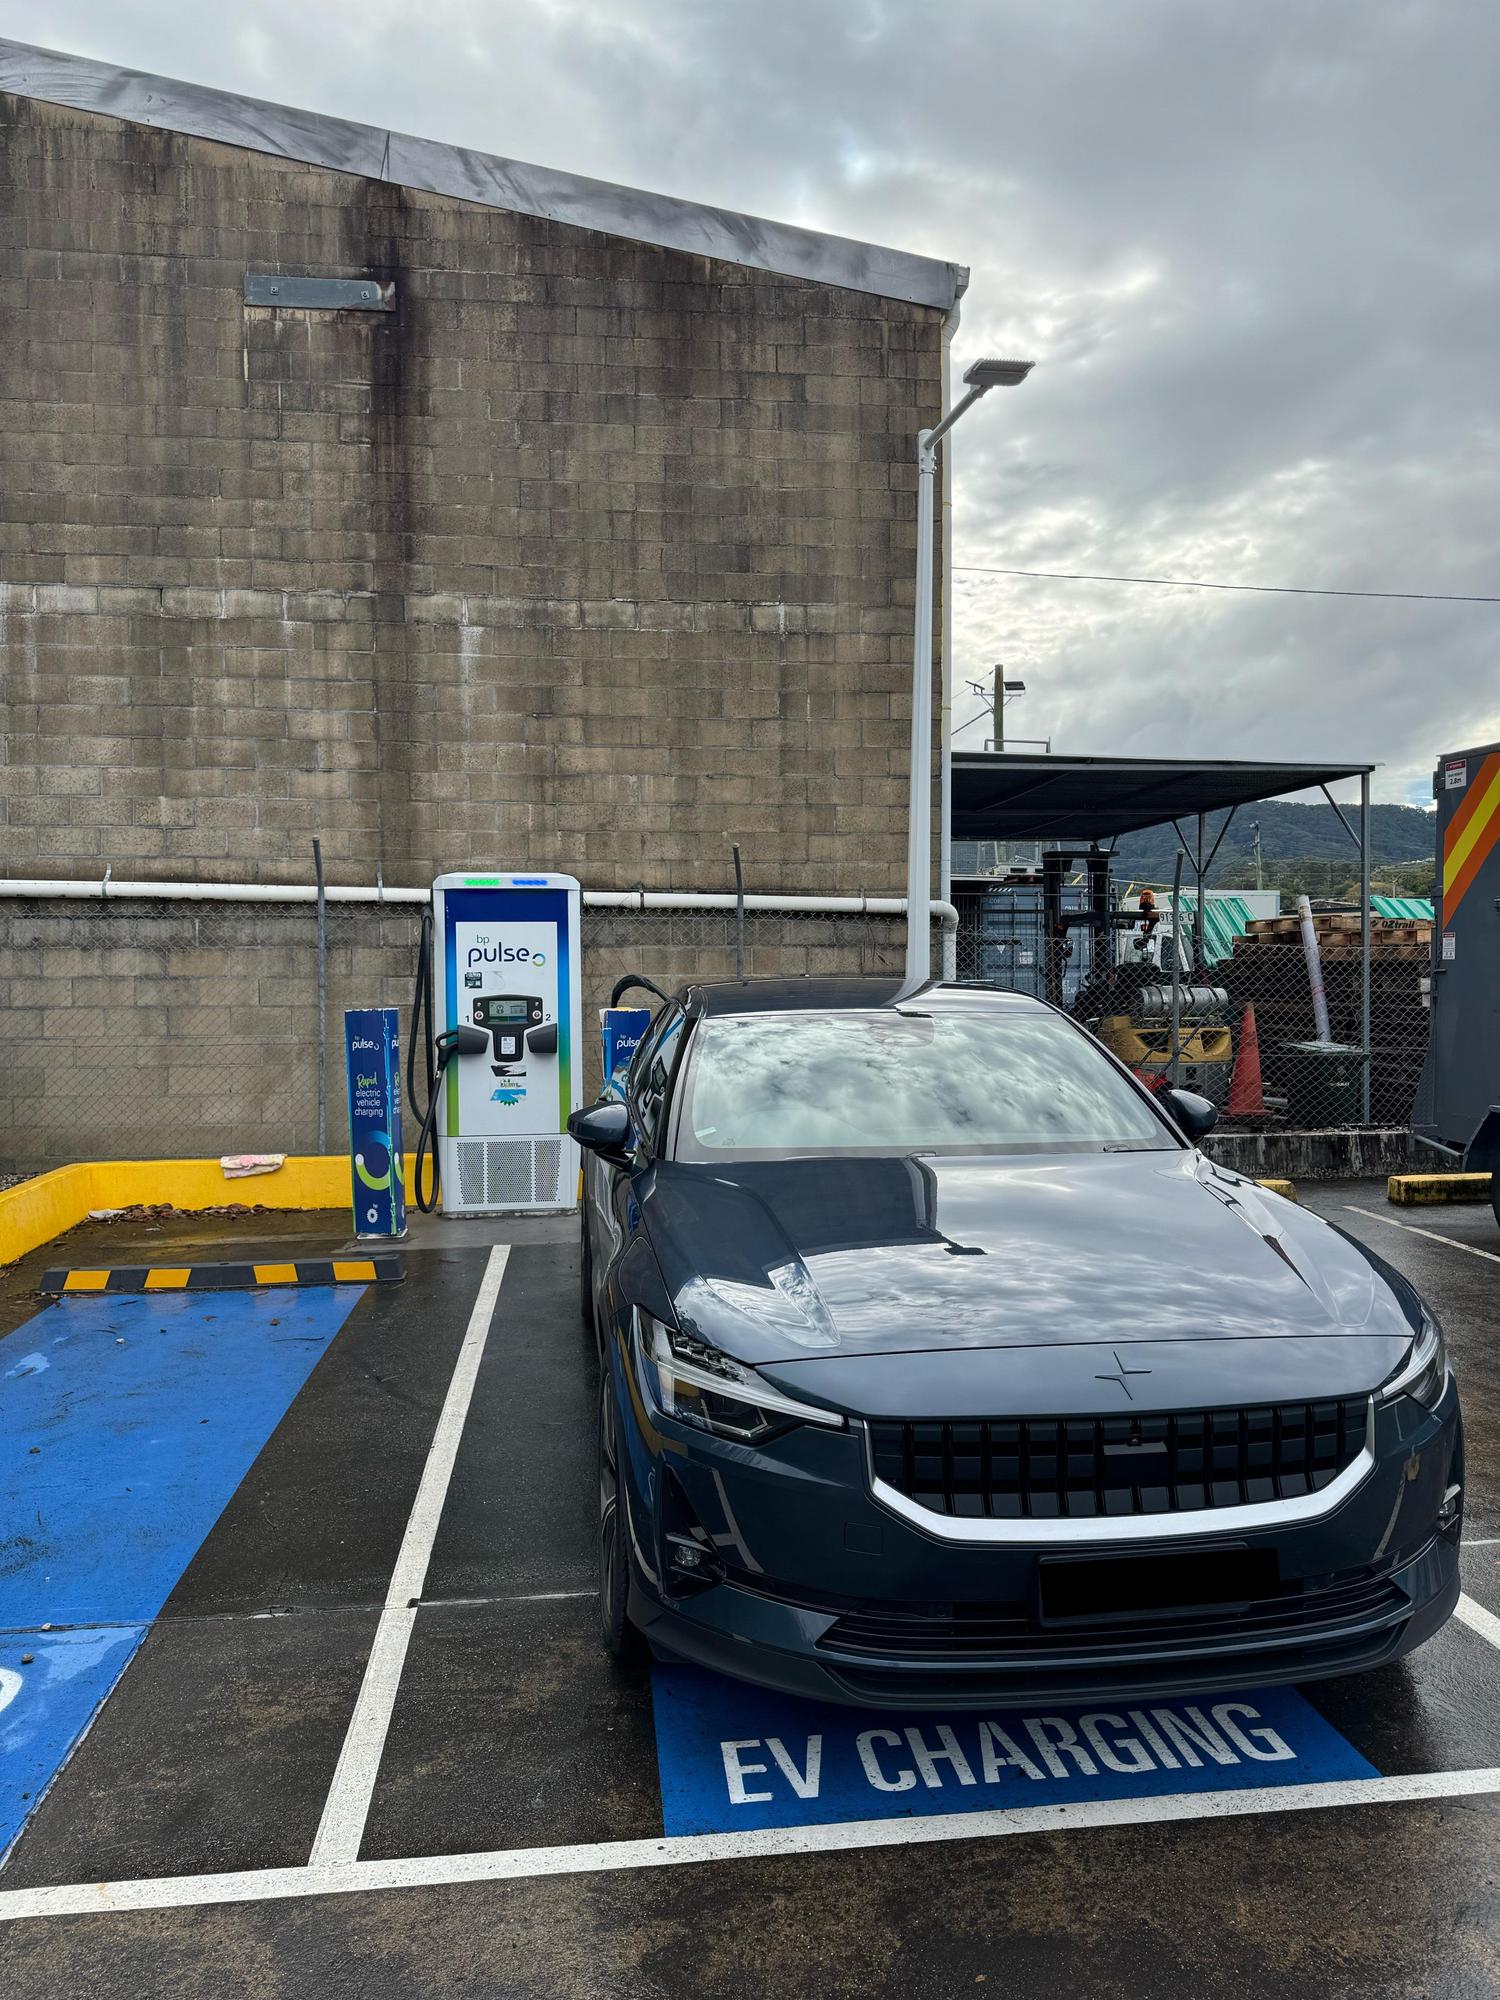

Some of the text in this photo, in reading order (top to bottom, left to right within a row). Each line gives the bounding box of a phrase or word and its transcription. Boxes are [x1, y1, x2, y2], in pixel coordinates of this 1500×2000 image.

[1159, 911, 1193, 922] 9136-C
[476, 934, 490, 945] bp
[468, 941, 530, 968] pulse
[546, 1014, 551, 1022] 2
[352, 1039, 374, 1051] pulse
[357, 1071, 378, 1088] Rapid
[356, 1088, 380, 1097] electric
[356, 1098, 380, 1106] vehicle
[354, 1108, 384, 1118] charging
[720, 1703, 1297, 1804] EV CHARGING
